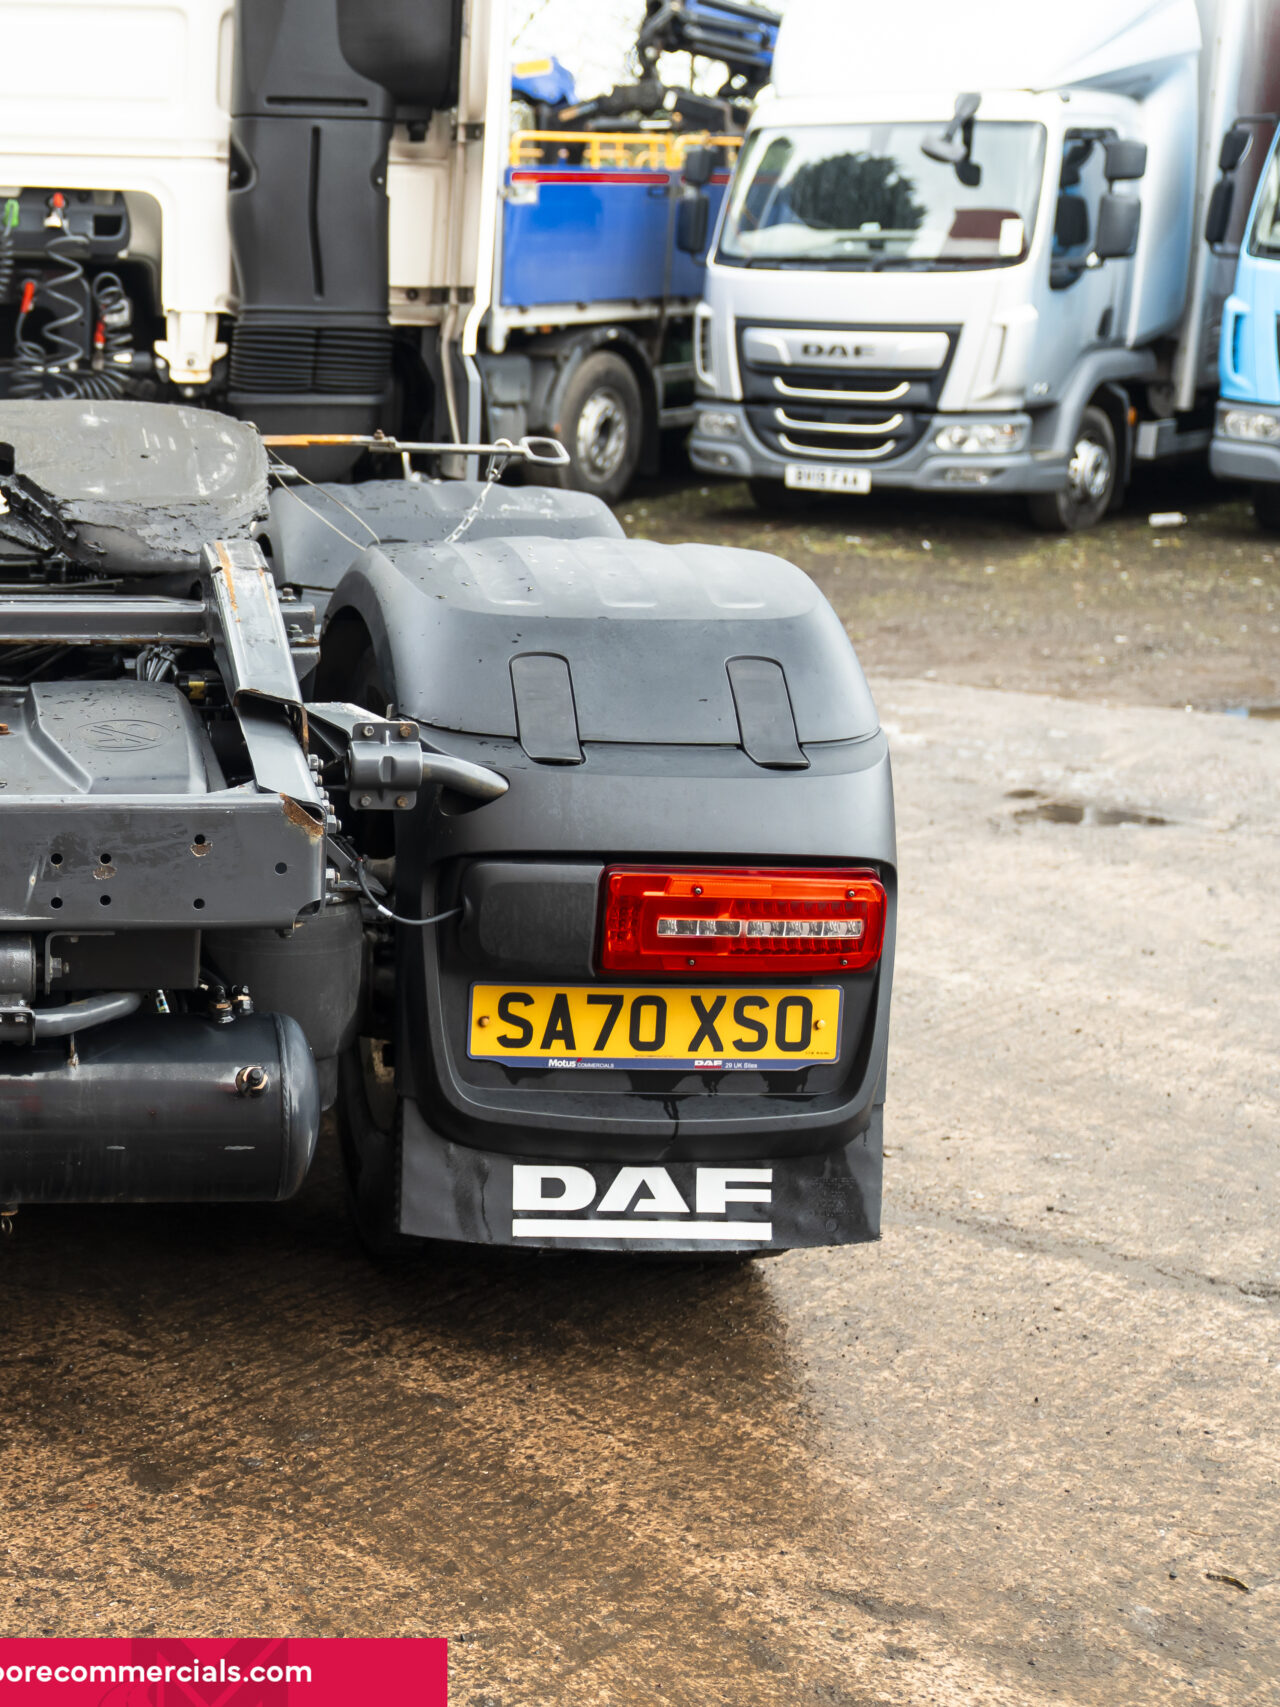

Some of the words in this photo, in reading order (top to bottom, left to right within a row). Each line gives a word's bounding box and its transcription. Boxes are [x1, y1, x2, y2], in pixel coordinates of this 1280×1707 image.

[802, 343, 877, 358] DAF
[496, 991, 668, 1052] SA70
[687, 995, 813, 1052] XSO
[548, 1059, 577, 1068] Motus
[513, 1164, 773, 1213] DAF
